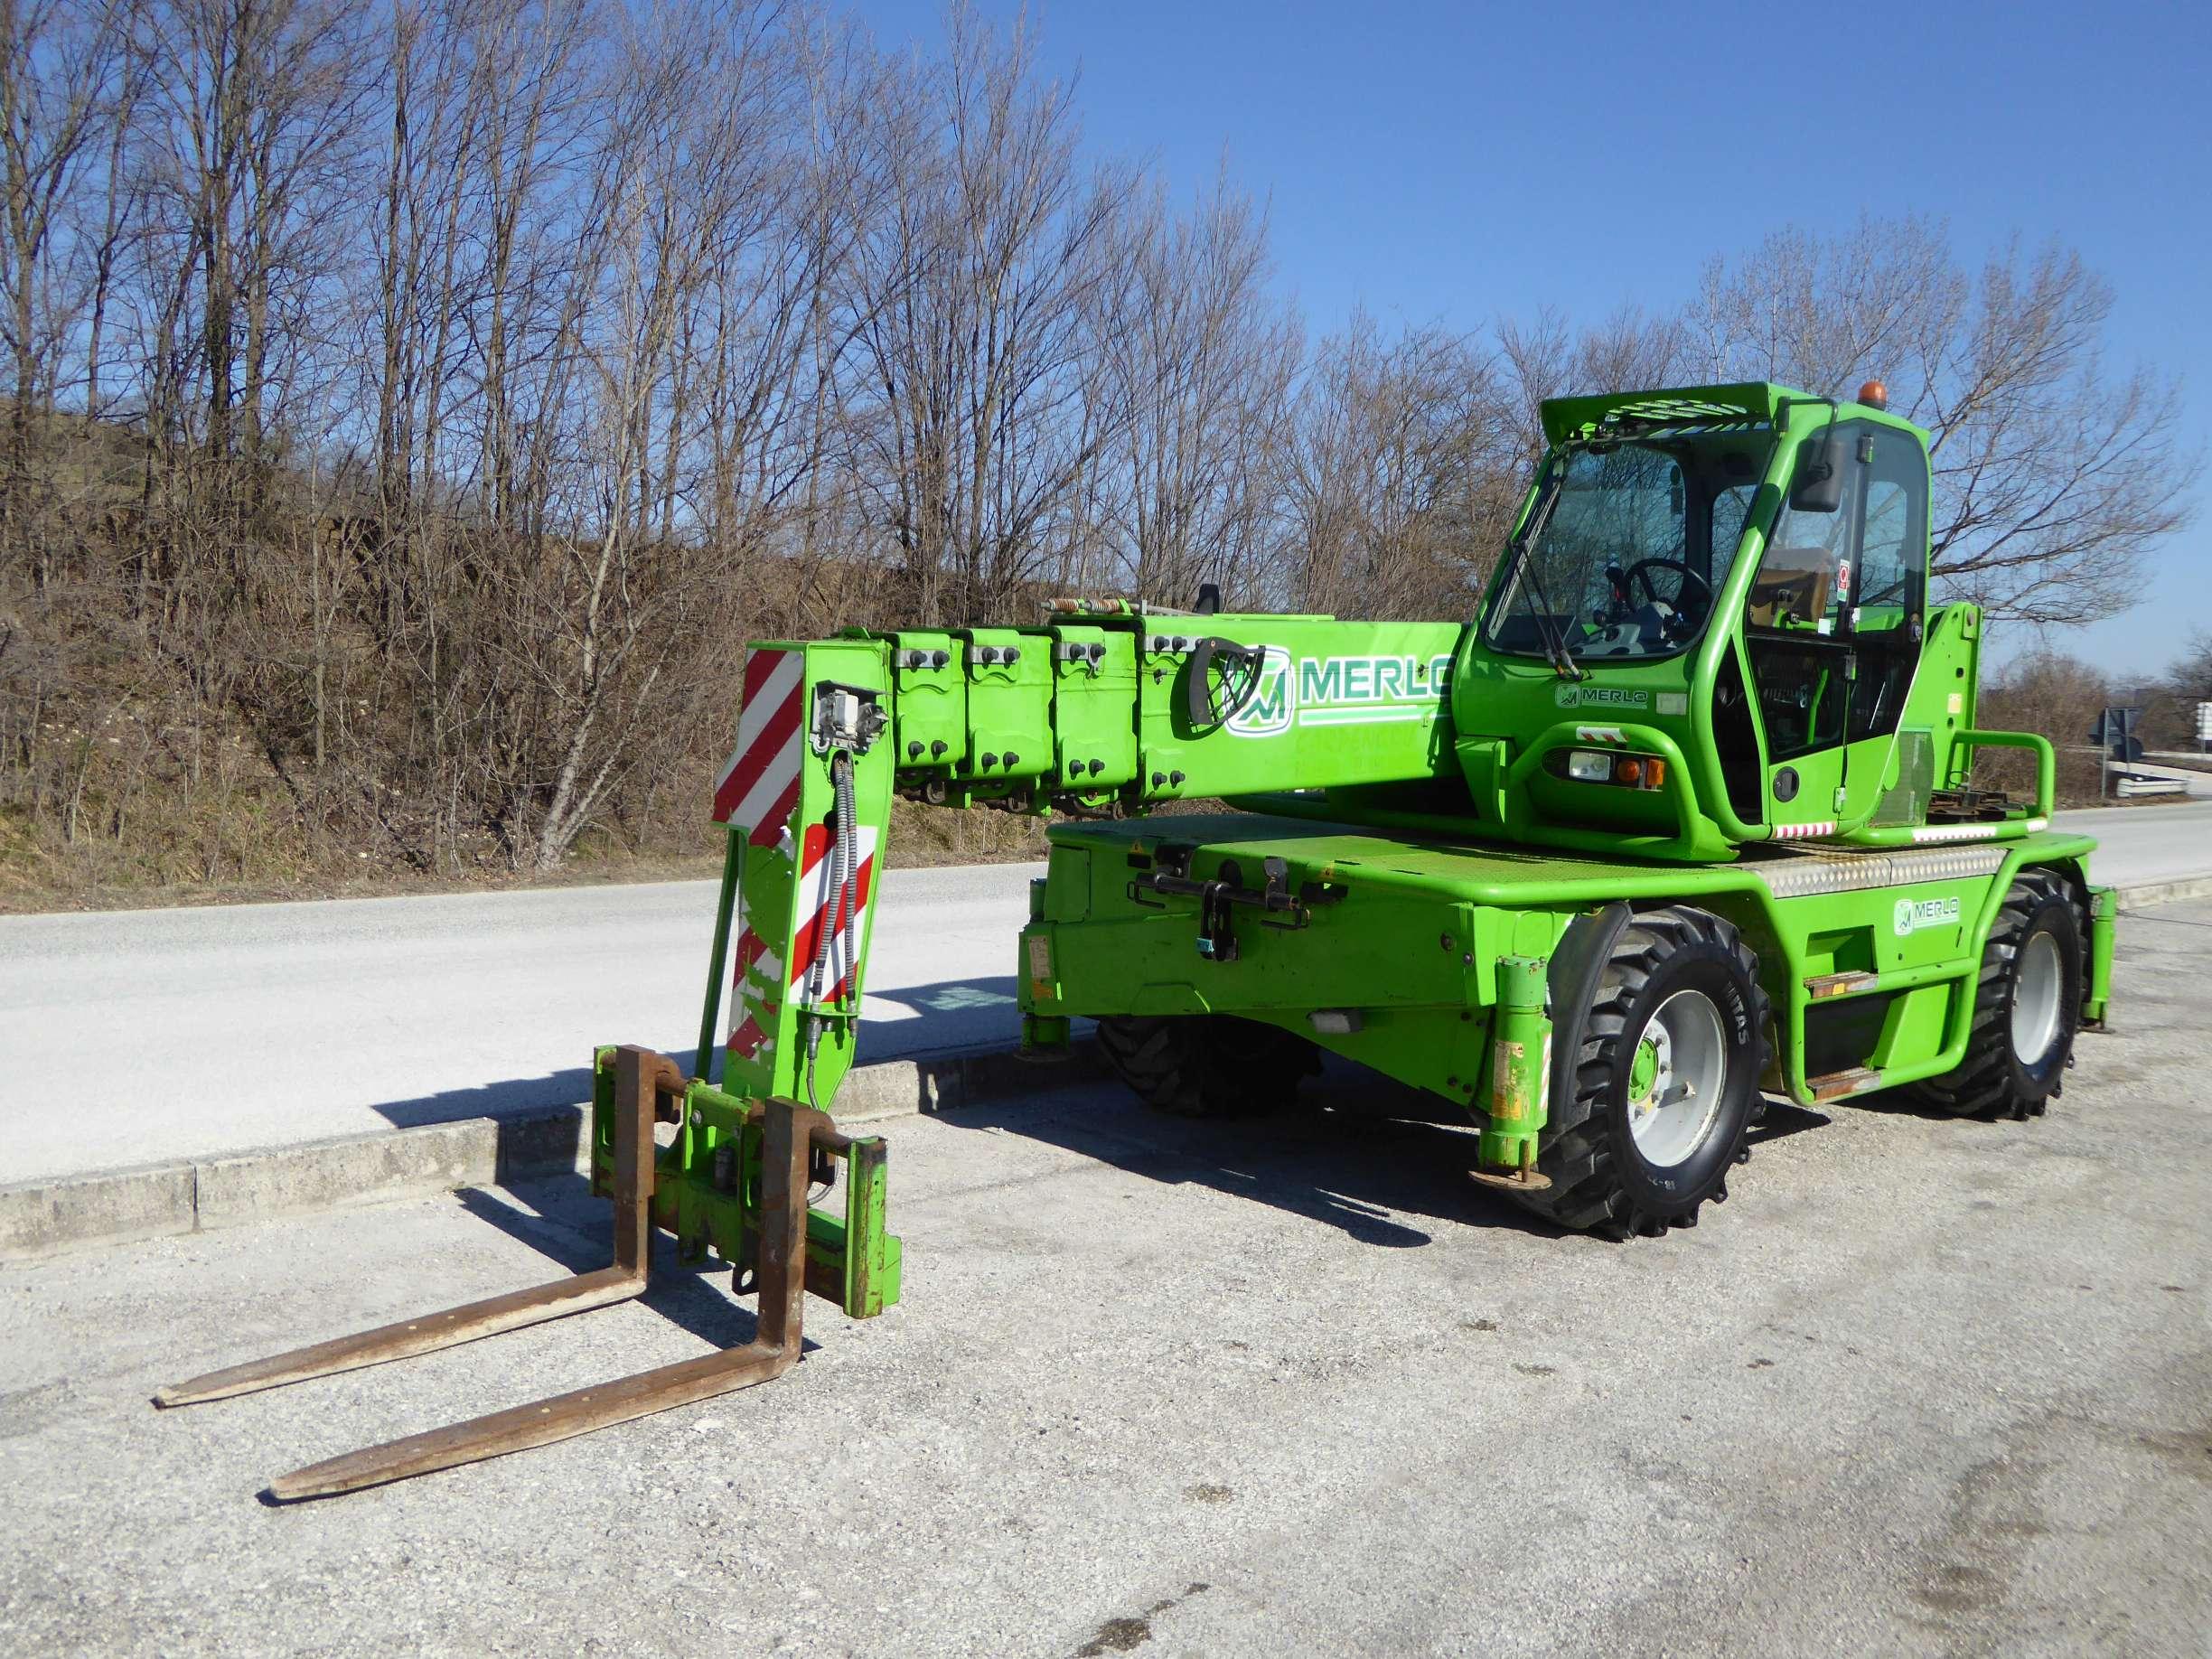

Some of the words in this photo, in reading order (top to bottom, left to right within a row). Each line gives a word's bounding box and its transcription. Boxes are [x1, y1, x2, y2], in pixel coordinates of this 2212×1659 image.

[1301, 657, 1457, 702] MERLO
[1582, 689, 1648, 703] MERLO
[1915, 898, 1958, 918] MERLO
